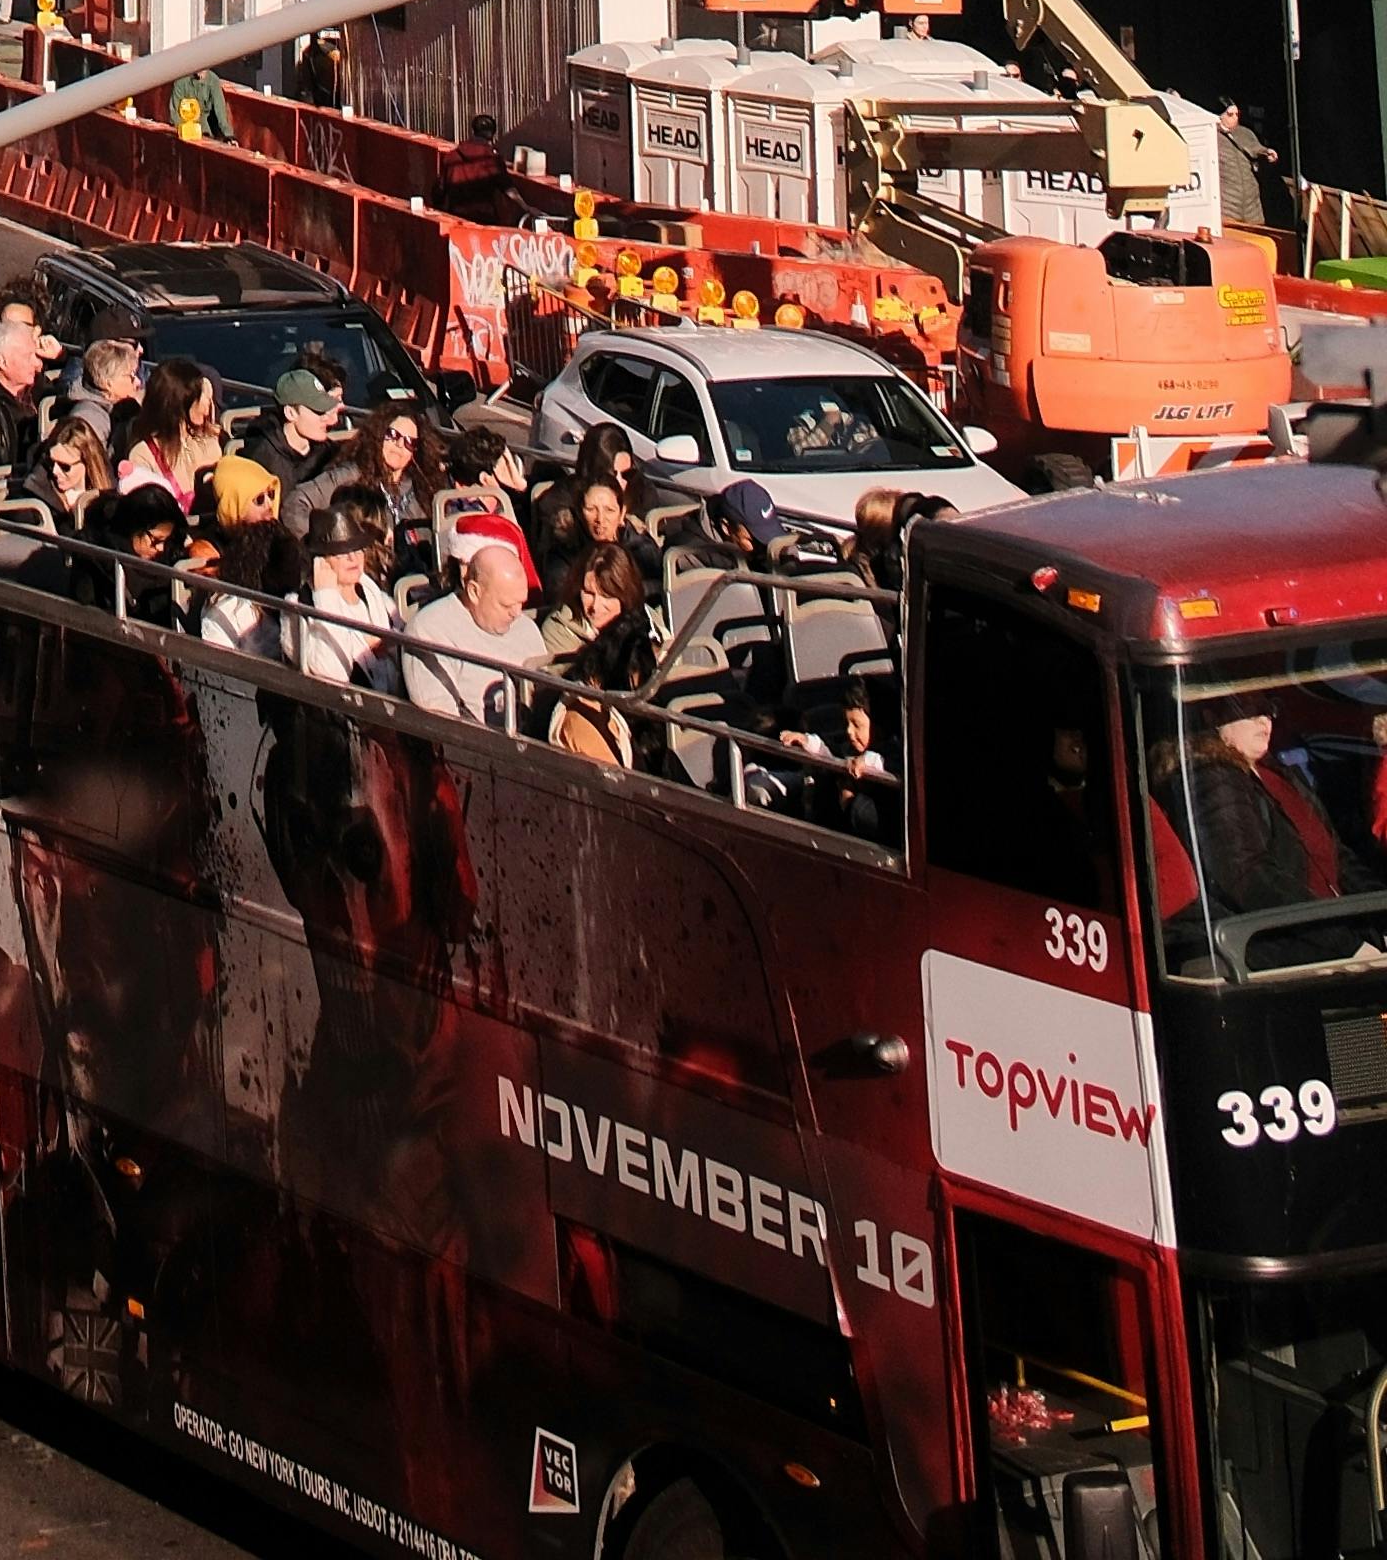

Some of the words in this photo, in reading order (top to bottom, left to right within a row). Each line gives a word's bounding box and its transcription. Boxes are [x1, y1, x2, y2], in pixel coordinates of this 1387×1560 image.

[648, 123, 700, 151] HEAD
[746, 136, 801, 164] HEAD
[1027, 170, 1106, 196] HEAD
[1154, 406, 1191, 421] JLG
[1196, 404, 1234, 419] LIFT
[1045, 906, 1108, 973] 339
[1217, 1080, 1335, 1149] 339
[498, 1074, 828, 1266] NOVEMBER
[853, 1217, 935, 1309] 10
[544, 1445, 570, 1472] VEC
[228, 1429, 245, 1457] GO
[246, 1438, 266, 1468] NEW
[267, 1448, 297, 1485] YORK
[298, 1465, 331, 1504] TOURS
[354, 1496, 388, 1535] USDOT
[398, 1519, 437, 1558] 2114416
[546, 1466, 572, 1494] TOR
